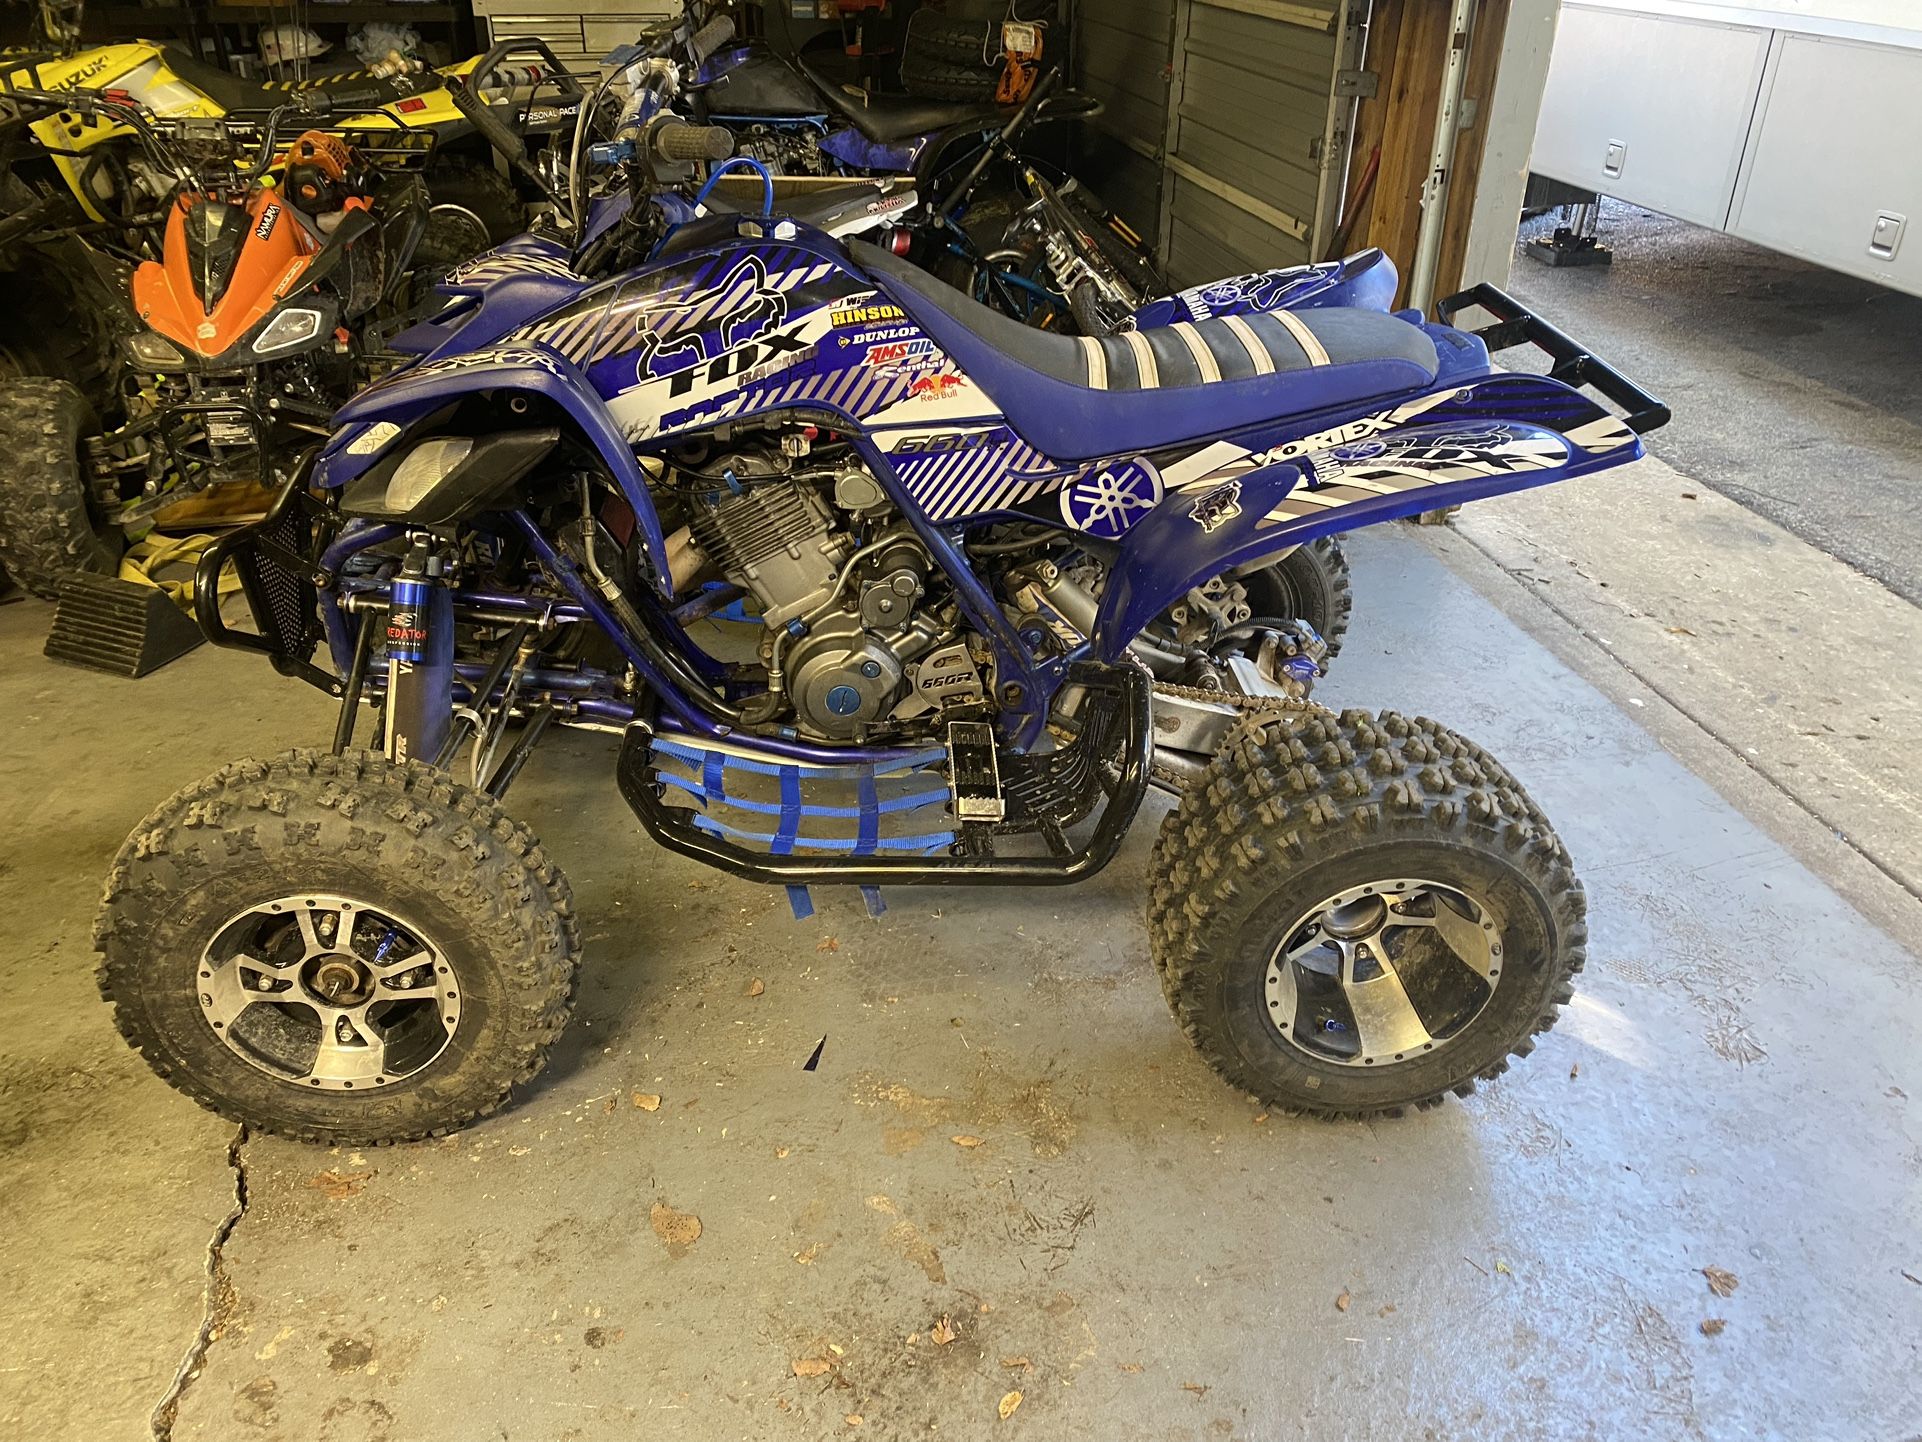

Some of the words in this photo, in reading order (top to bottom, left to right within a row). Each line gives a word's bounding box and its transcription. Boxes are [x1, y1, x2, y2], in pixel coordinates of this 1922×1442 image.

[519, 110, 558, 122] PRSONAL
[560, 106, 577, 116] PACE
[256, 204, 280, 239] NAMURA
[831, 306, 905, 327] HINSON
[852, 326, 920, 345] DUNLOP
[669, 321, 813, 398] FOX
[864, 339, 936, 366] AMSOIL
[738, 345, 819, 386] RACING
[920, 392, 940, 403] Red
[941, 389, 958, 400] Bull
[891, 432, 990, 455] 660
[1251, 410, 1397, 468] VORTEX
[387, 627, 428, 640] REDATOR
[921, 671, 974, 690] 660R
